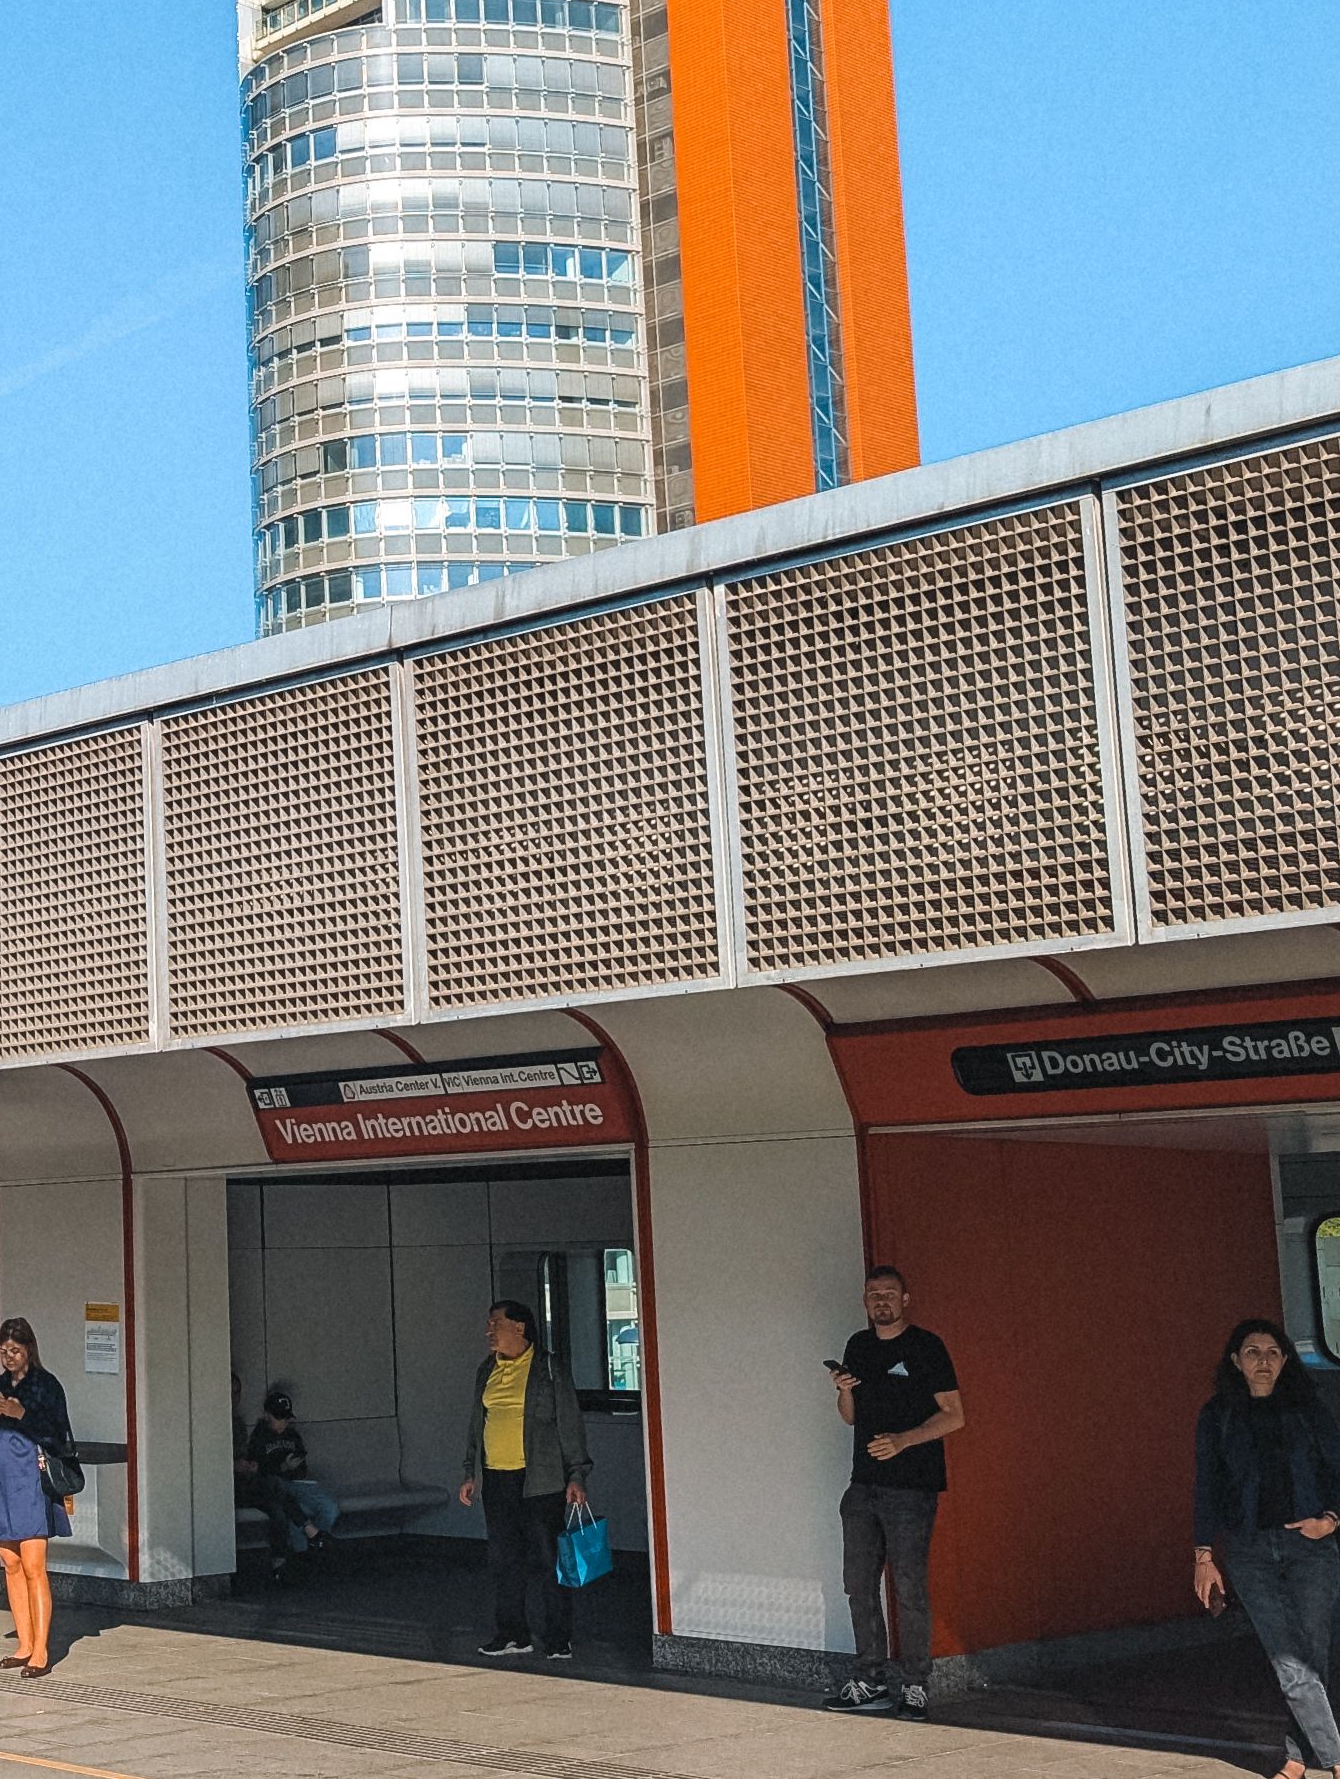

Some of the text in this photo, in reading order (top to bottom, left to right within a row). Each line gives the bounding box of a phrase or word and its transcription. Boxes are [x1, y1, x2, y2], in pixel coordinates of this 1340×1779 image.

[1041, 1030, 1331, 1075] Donau-City-Straße
[358, 1082, 394, 1096] Austria
[395, 1079, 430, 1093] Center
[445, 1075, 461, 1088] VIC
[462, 1073, 498, 1087] Vienna
[518, 1067, 556, 1083] Centre
[275, 1098, 604, 1145] Vienna International Centre
